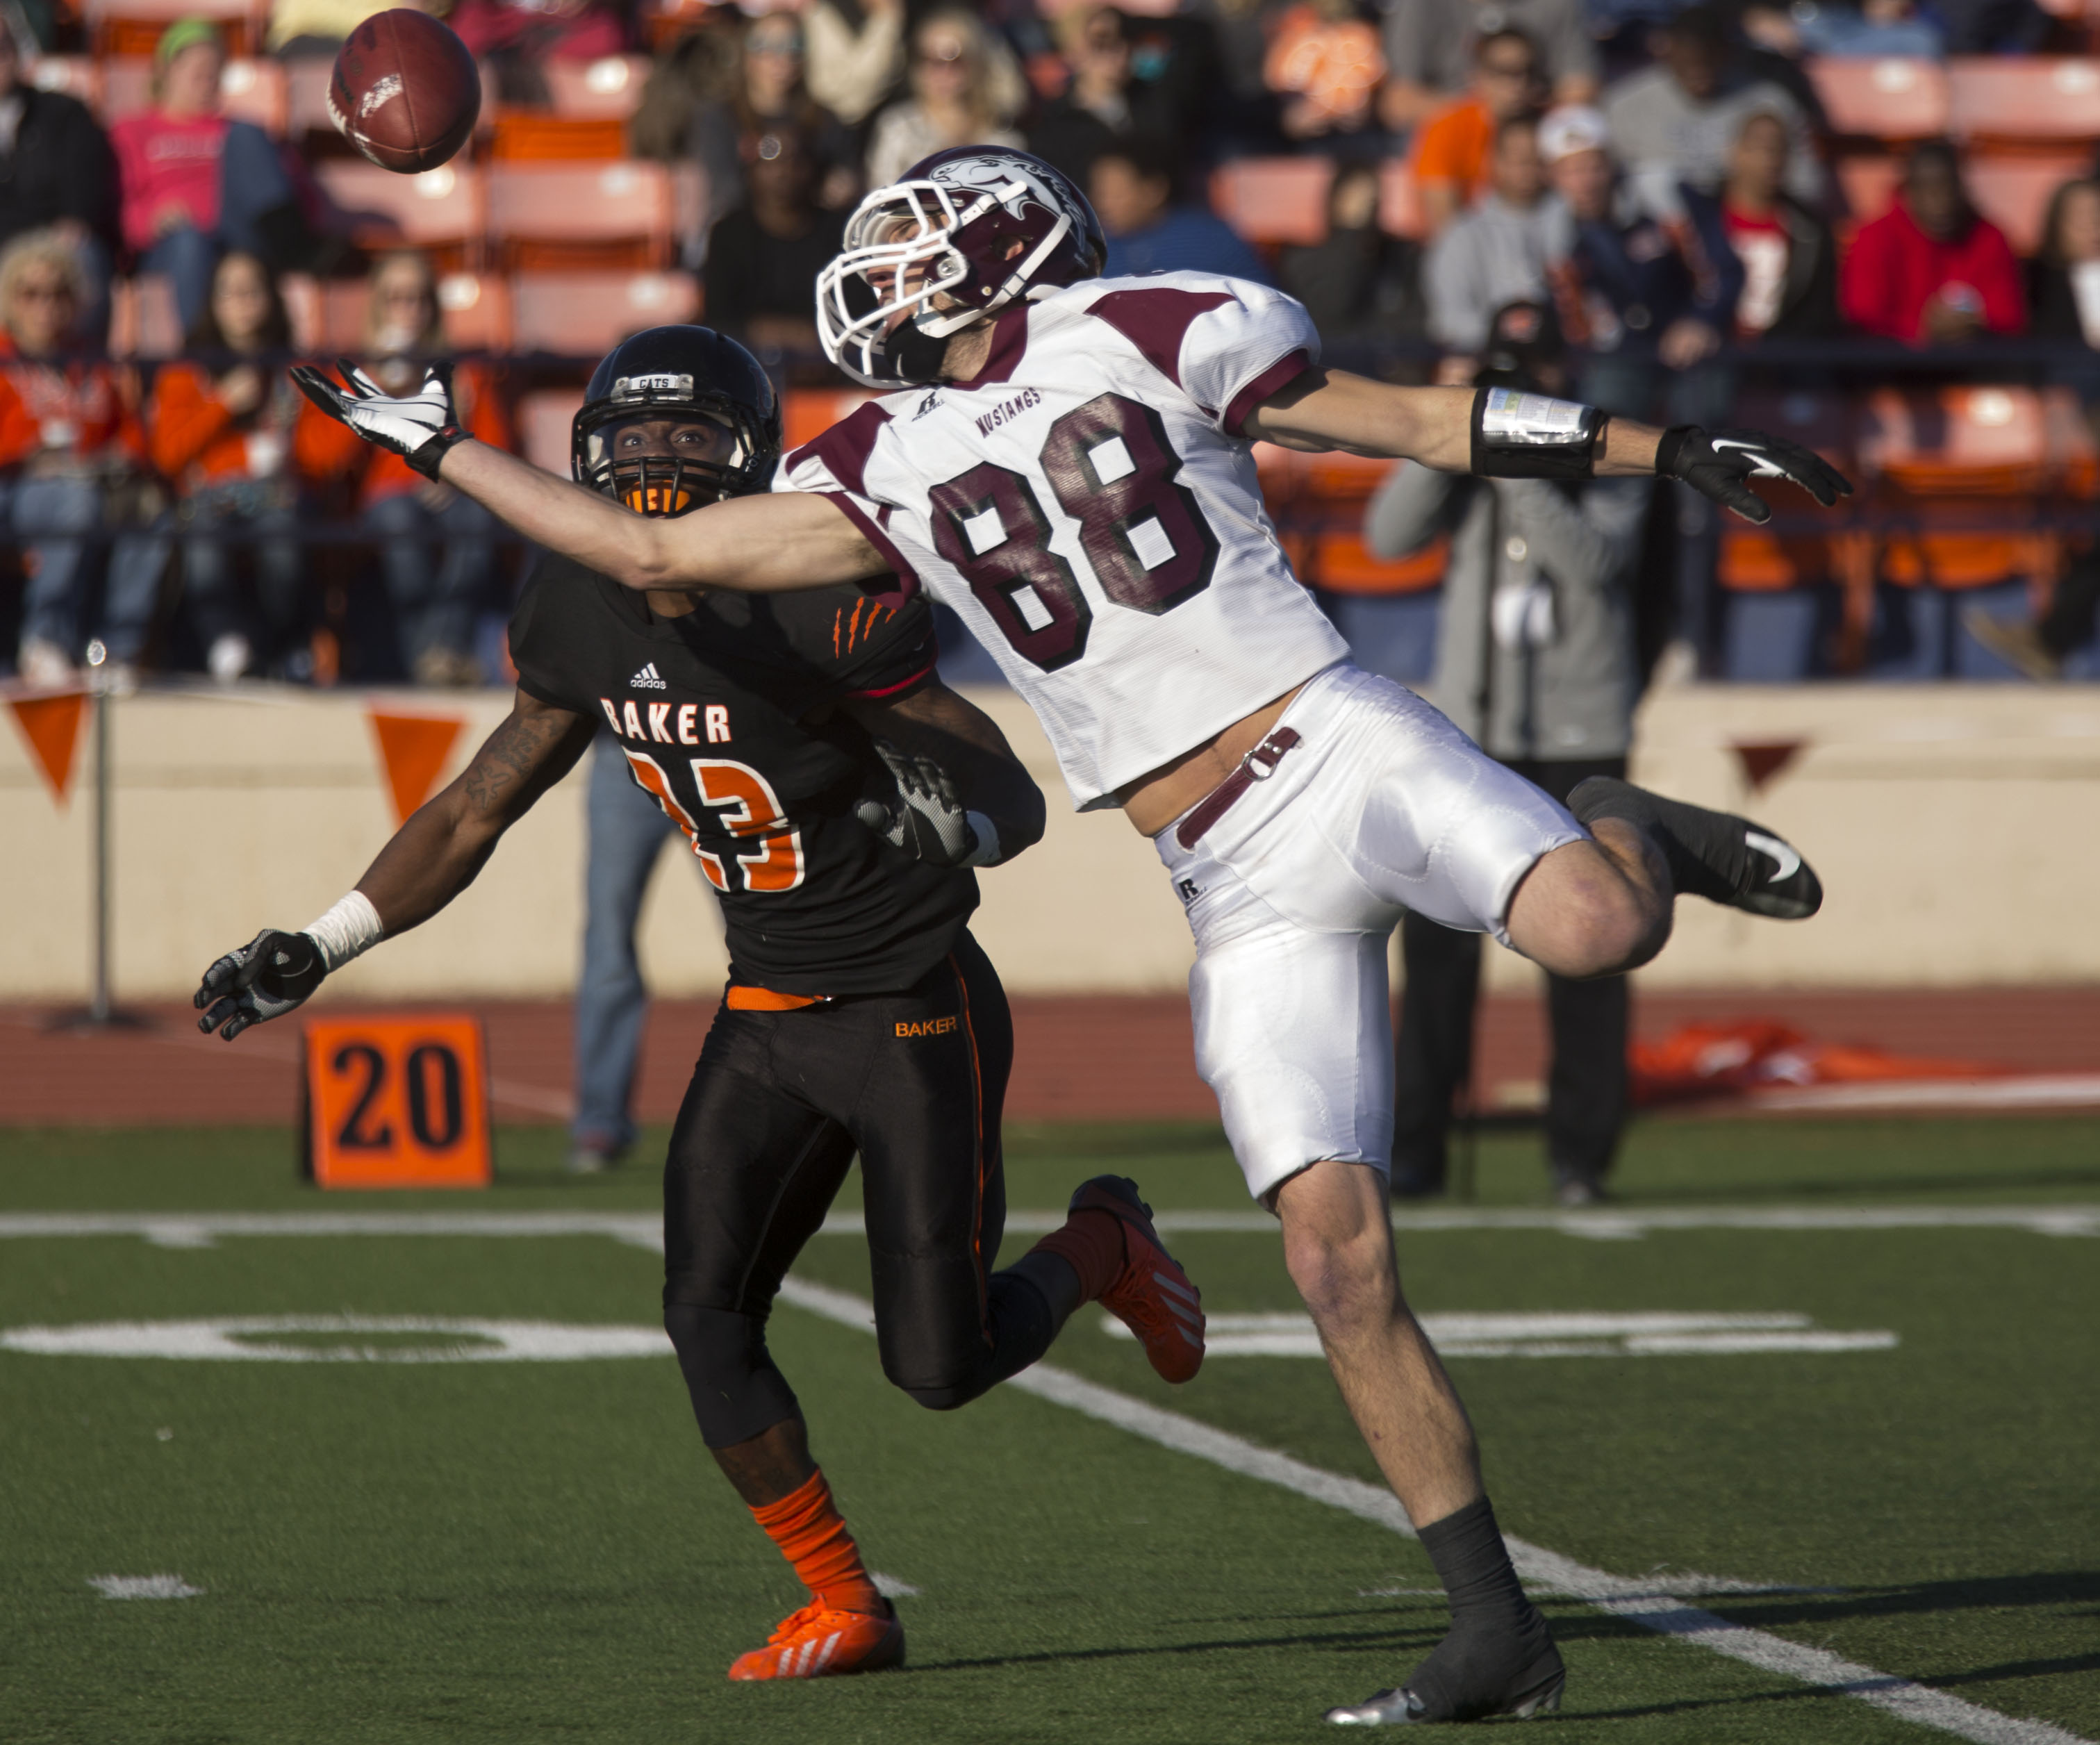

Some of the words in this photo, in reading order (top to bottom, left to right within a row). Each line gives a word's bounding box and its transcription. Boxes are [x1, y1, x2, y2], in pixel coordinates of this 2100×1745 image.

[639, 378, 669, 389] CATS
[975, 387, 1041, 439] MUSTANGS
[927, 390, 1221, 674] 88
[630, 678, 667, 689] adidas
[600, 697, 731, 745] BAKER
[895, 1016, 957, 1038] BAKER
[333, 1043, 463, 1151] 20
